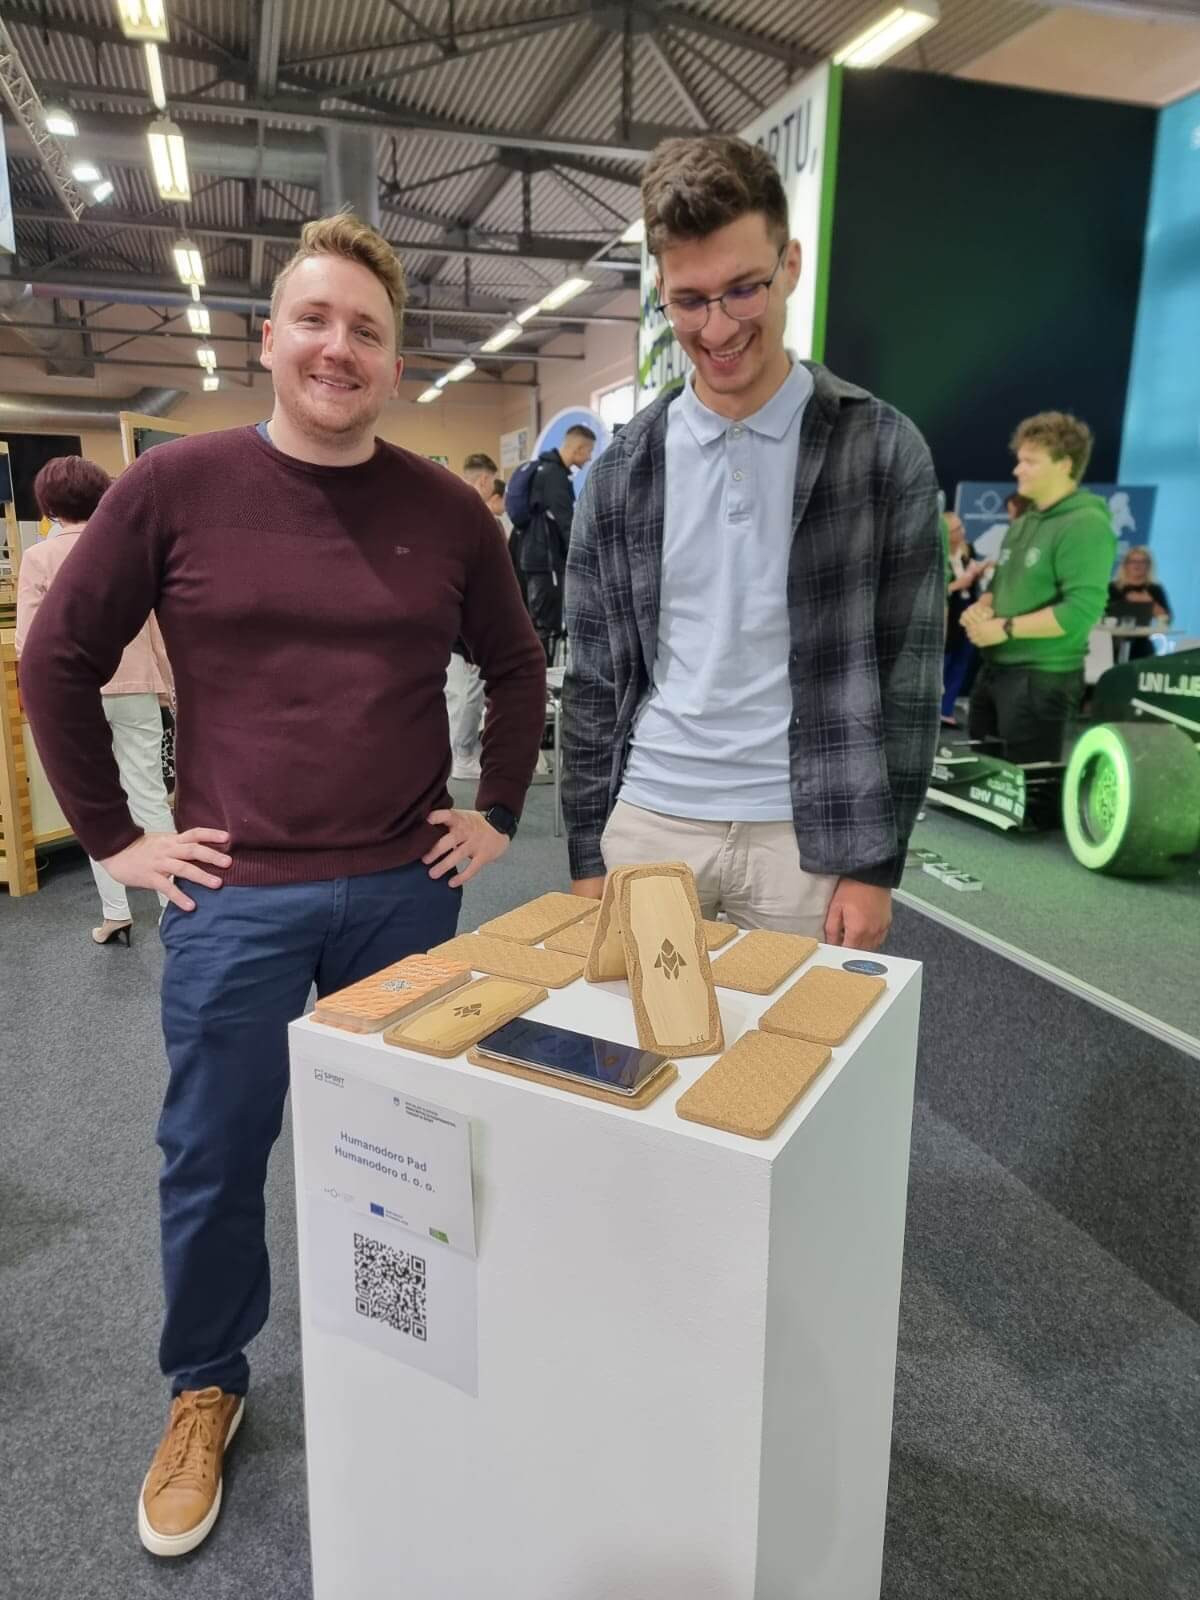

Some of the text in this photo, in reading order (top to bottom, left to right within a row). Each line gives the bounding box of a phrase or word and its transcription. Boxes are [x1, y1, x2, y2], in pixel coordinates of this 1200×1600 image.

[334, 1145, 436, 1193] Humanodoro d. o. o.
[340, 1131, 428, 1172] Humanodoro Pad
